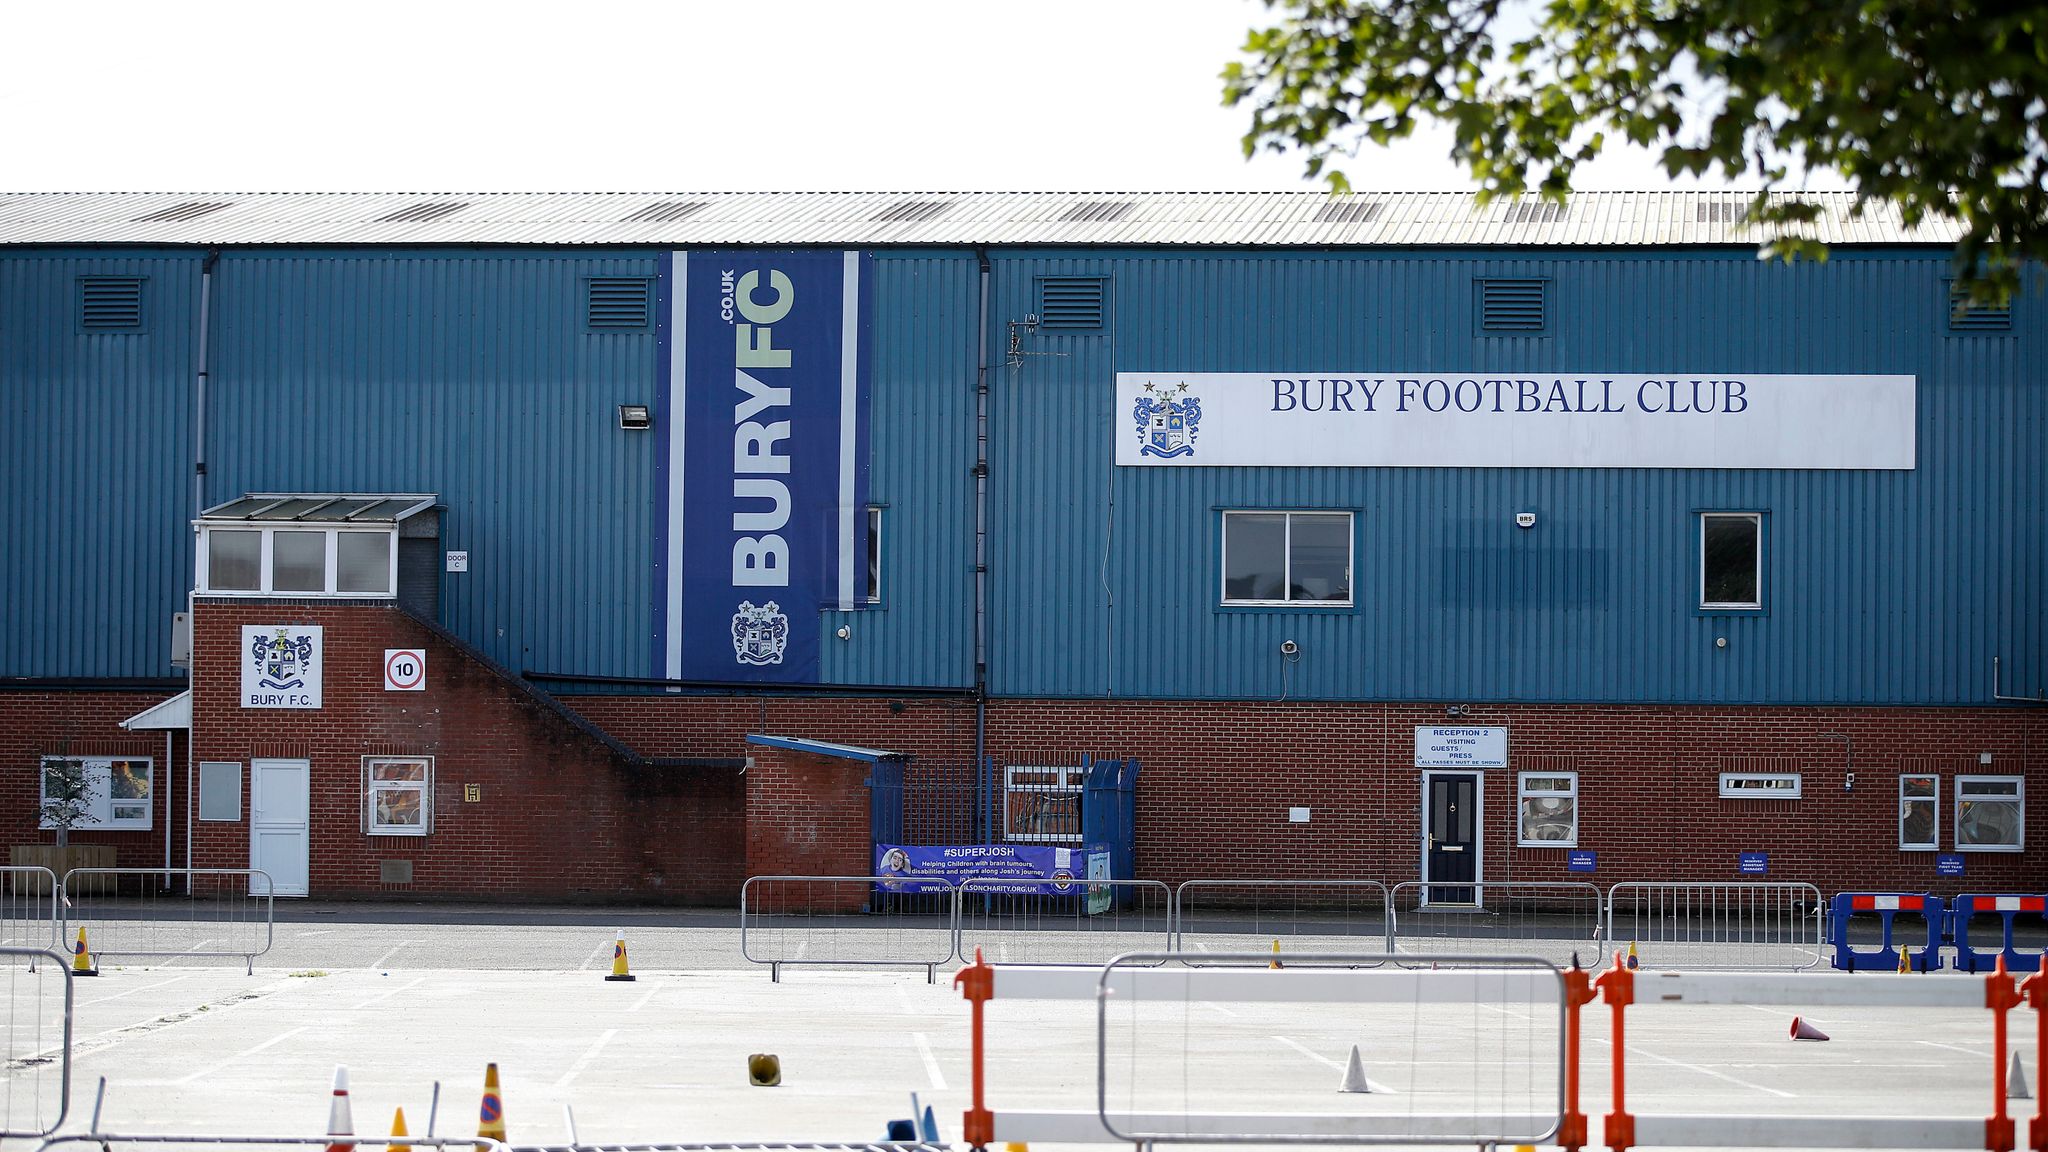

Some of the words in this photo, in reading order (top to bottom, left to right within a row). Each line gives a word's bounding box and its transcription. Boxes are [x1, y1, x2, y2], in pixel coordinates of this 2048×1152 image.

[721, 269, 734, 325] .CO.UK
[1270, 379, 1385, 412] BURY
[1396, 379, 1626, 413] FOOTBALL
[1636, 380, 1749, 414] CLUB
[395, 662, 414, 677] 10
[250, 694, 285, 705] BURY
[289, 694, 313, 706] F.C.
[943, 847, 1015, 857] #SUPERJOSH
[921, 860, 946, 868] Helping
[1006, 860, 1035, 869] tumours,
[980, 868, 999, 876] along
[1020, 868, 1045, 877] journey
